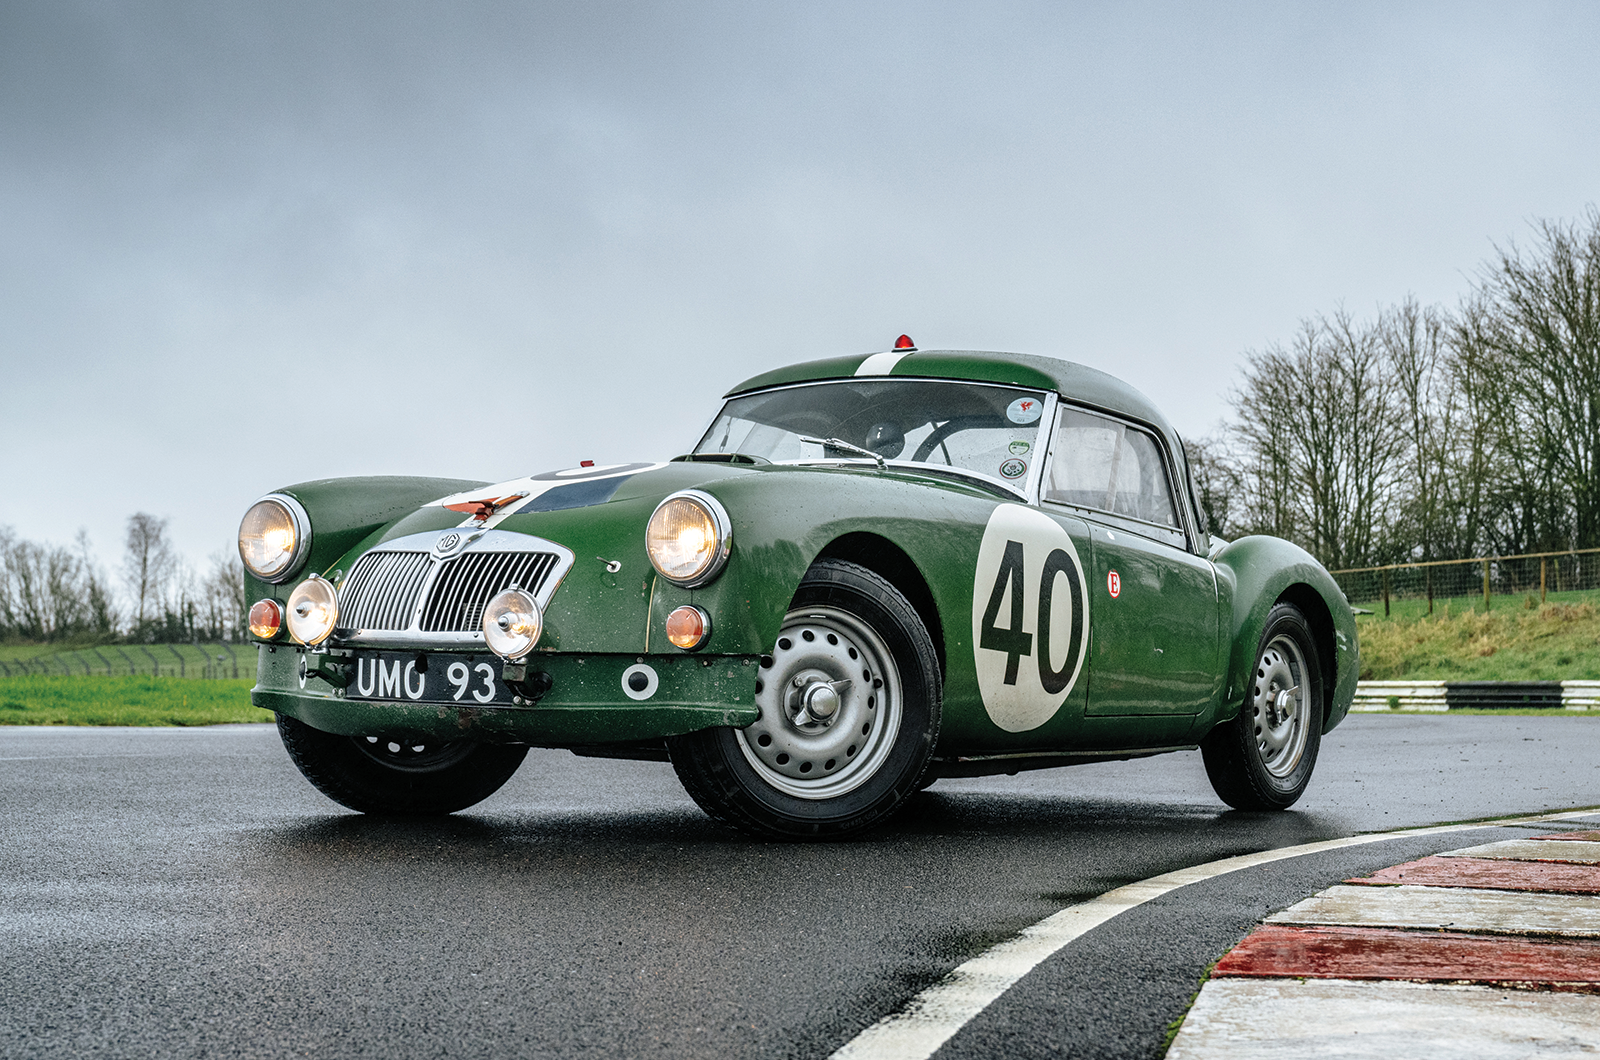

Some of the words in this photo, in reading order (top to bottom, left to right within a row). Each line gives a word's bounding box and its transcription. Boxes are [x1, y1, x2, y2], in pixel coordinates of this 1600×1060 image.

[1110, 573, 1119, 594] E
[979, 539, 1084, 695] 40
[357, 657, 426, 700] UMO
[446, 661, 496, 704] 93
